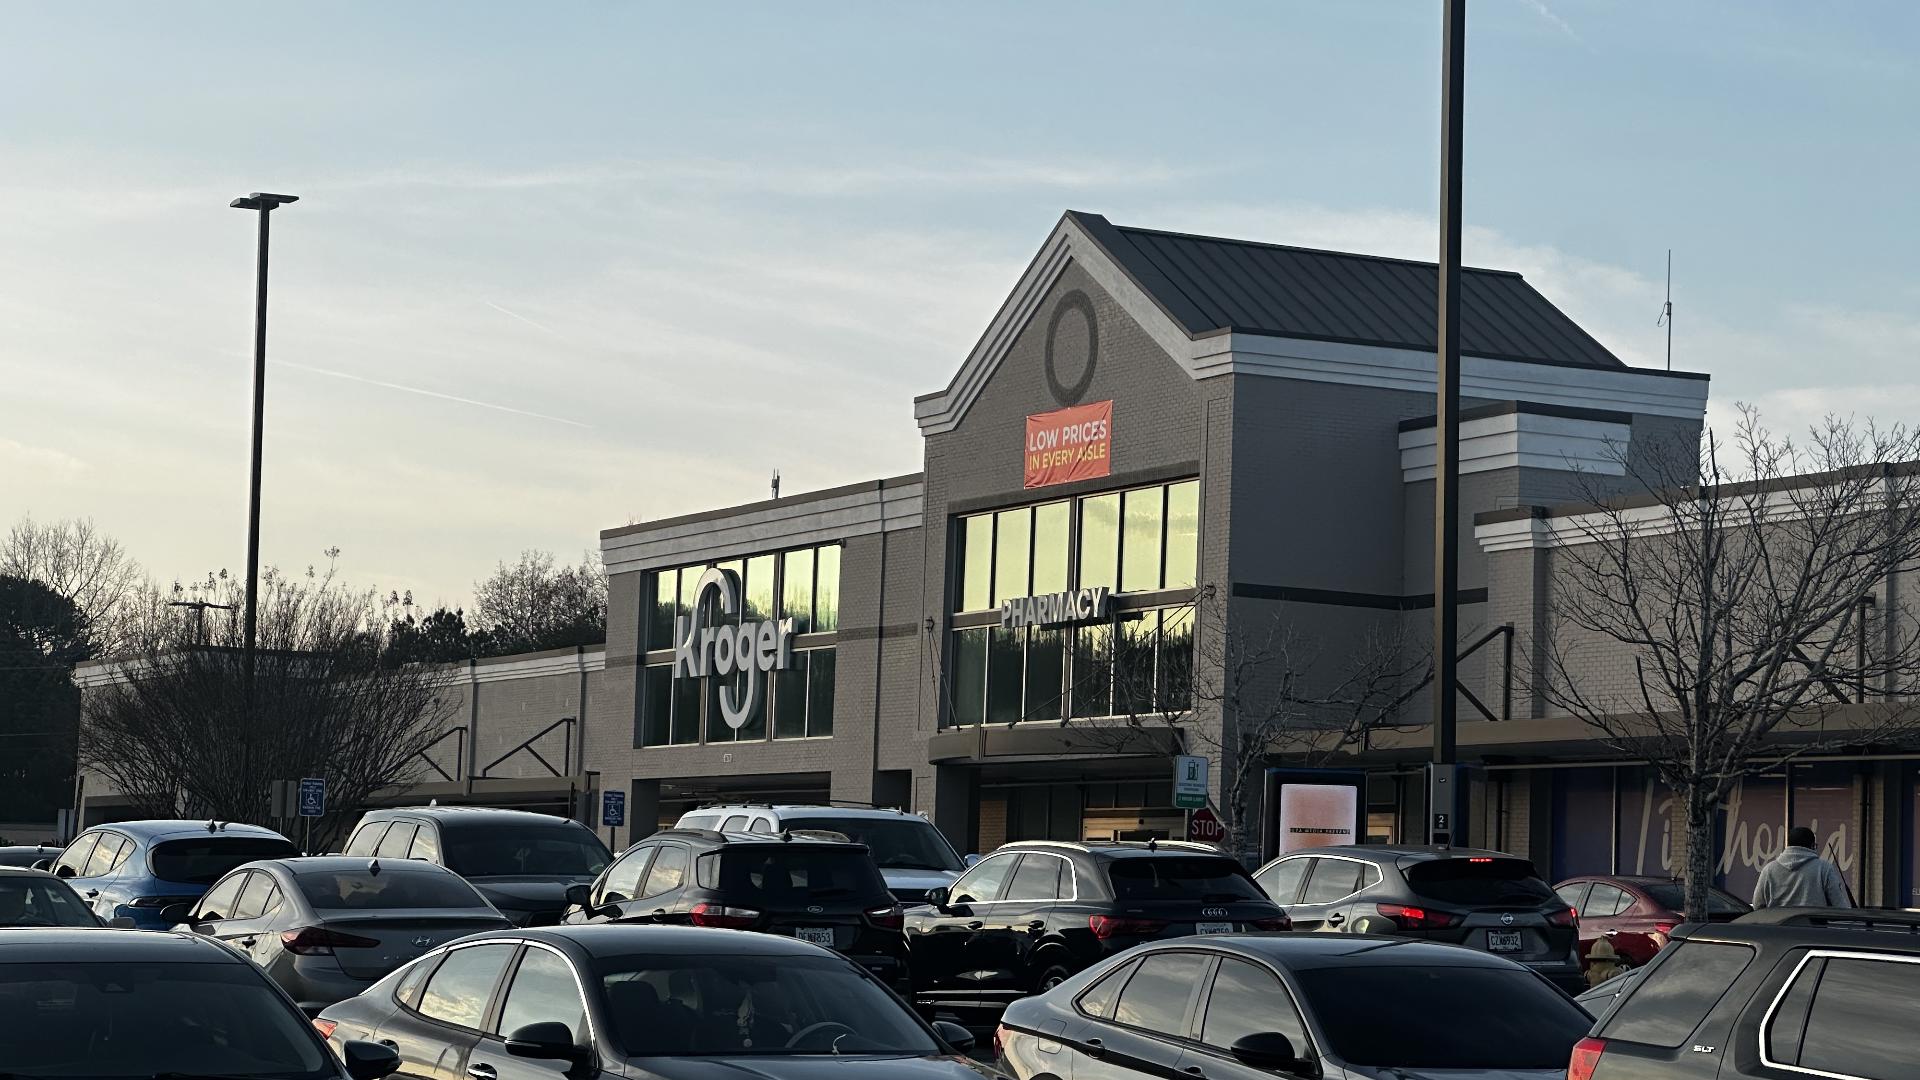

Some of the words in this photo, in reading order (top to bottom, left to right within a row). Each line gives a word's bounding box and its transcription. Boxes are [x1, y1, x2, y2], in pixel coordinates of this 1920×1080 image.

[1029, 428, 1060, 452] LOW
[1062, 419, 1107, 446] PRICES
[1029, 455, 1040, 471] IN
[1042, 447, 1075, 469] EVERY
[1076, 442, 1106, 463] AISLE
[1001, 587, 1109, 628] PHARMACY
[674, 567, 795, 729] Kroger
[1191, 819, 1223, 836] STOP
[1438, 815, 1445, 824] 2
[1693, 1044, 1715, 1053] SLT
